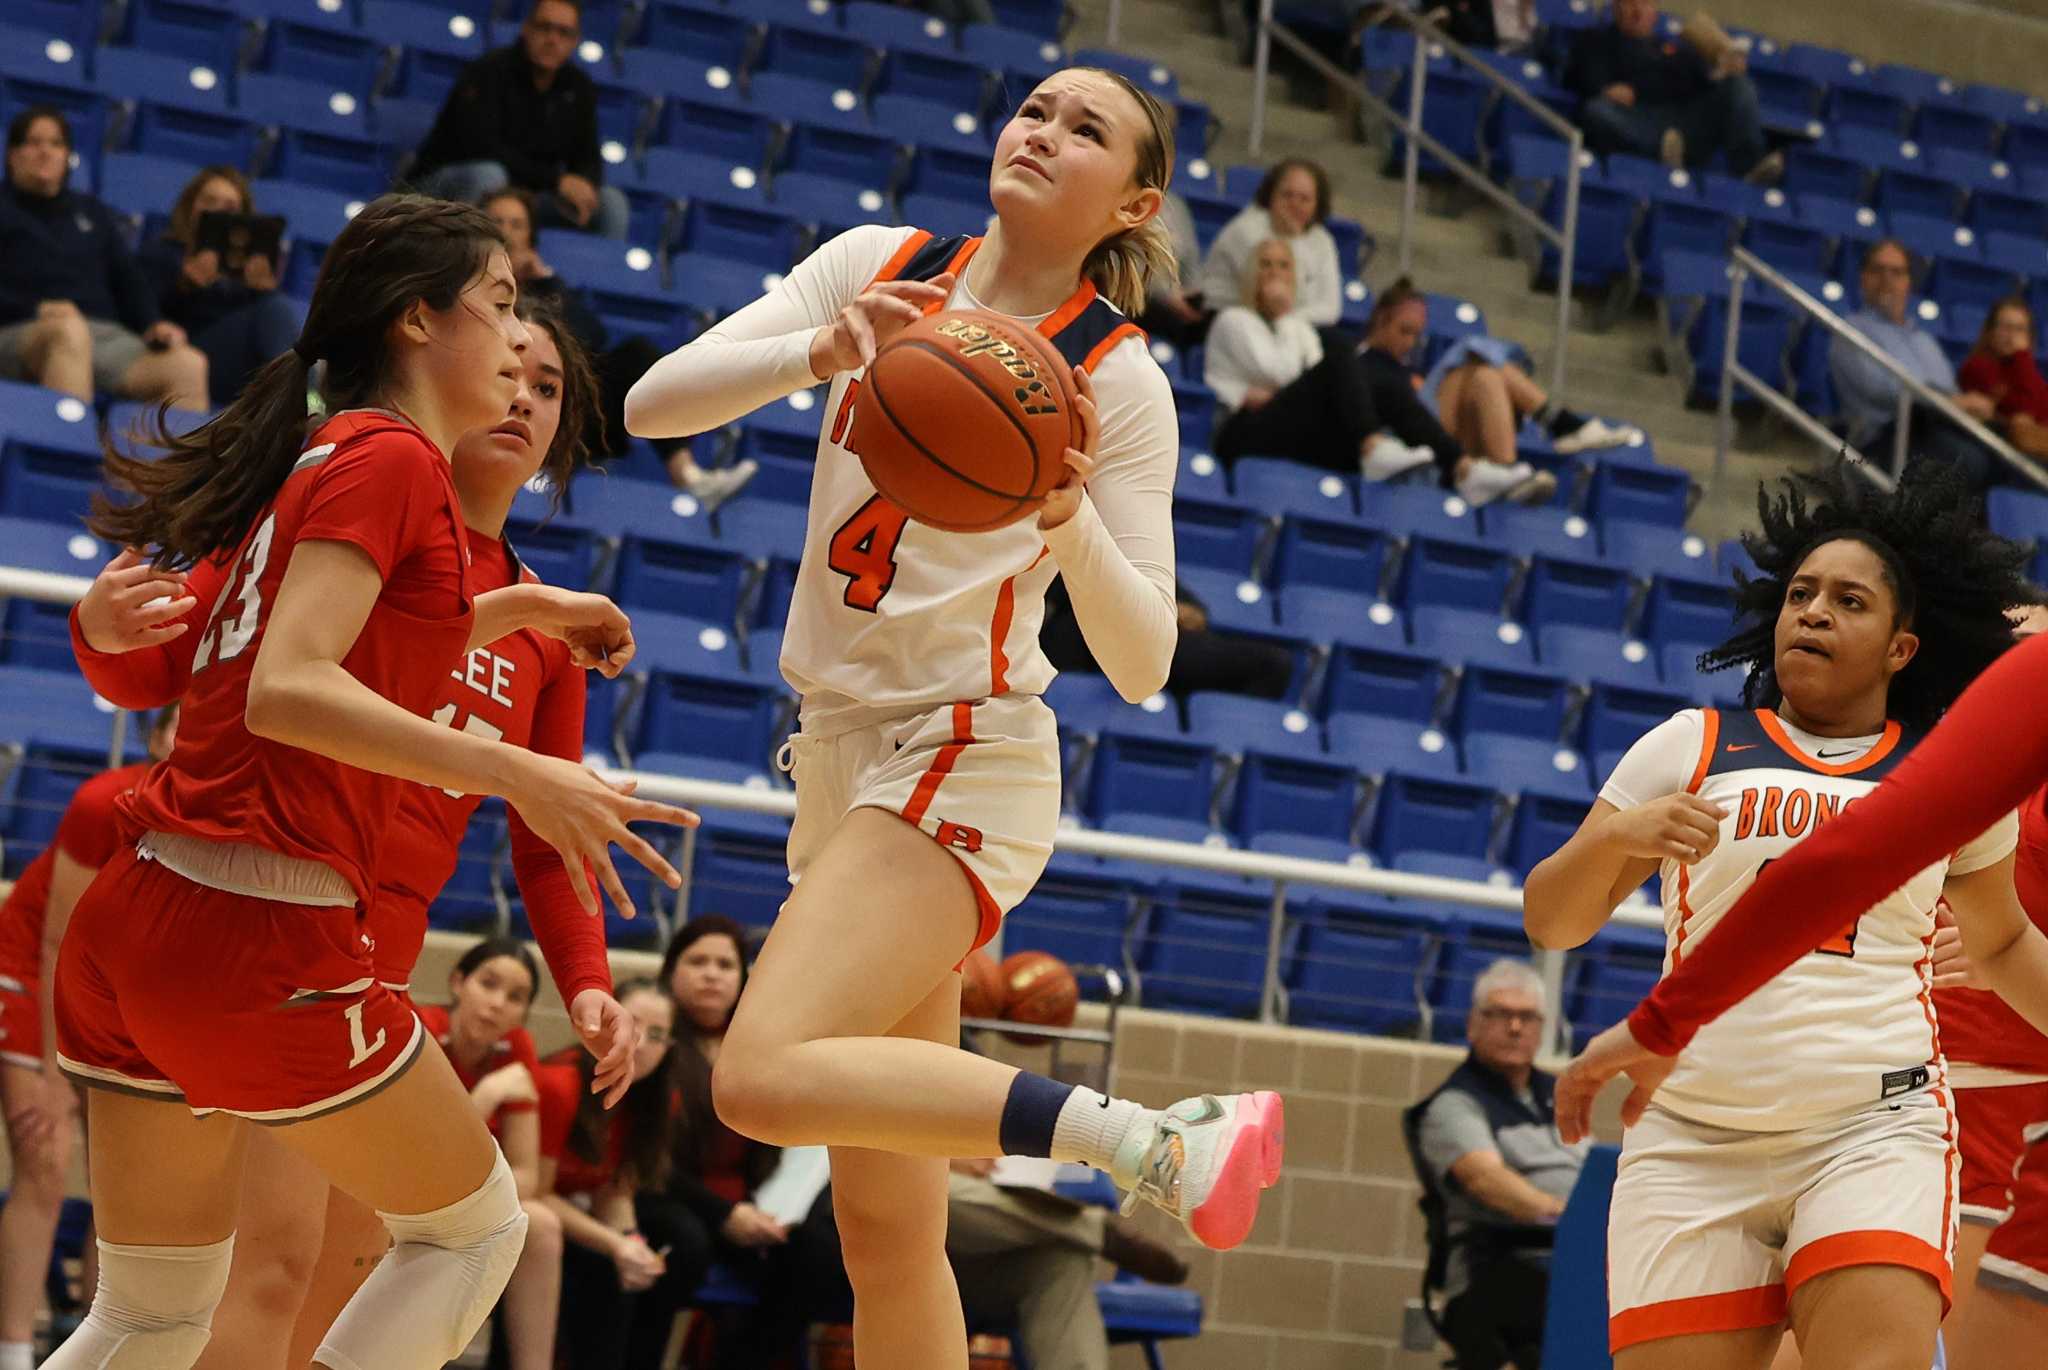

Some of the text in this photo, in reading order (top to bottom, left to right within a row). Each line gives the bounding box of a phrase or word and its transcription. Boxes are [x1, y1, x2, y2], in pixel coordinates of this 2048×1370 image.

[936, 318, 1059, 416] Baden
[828, 492, 909, 614] 4
[451, 647, 516, 709] EE
[934, 817, 984, 854] B
[1733, 786, 1859, 841] BRON
[344, 999, 387, 1070] L
